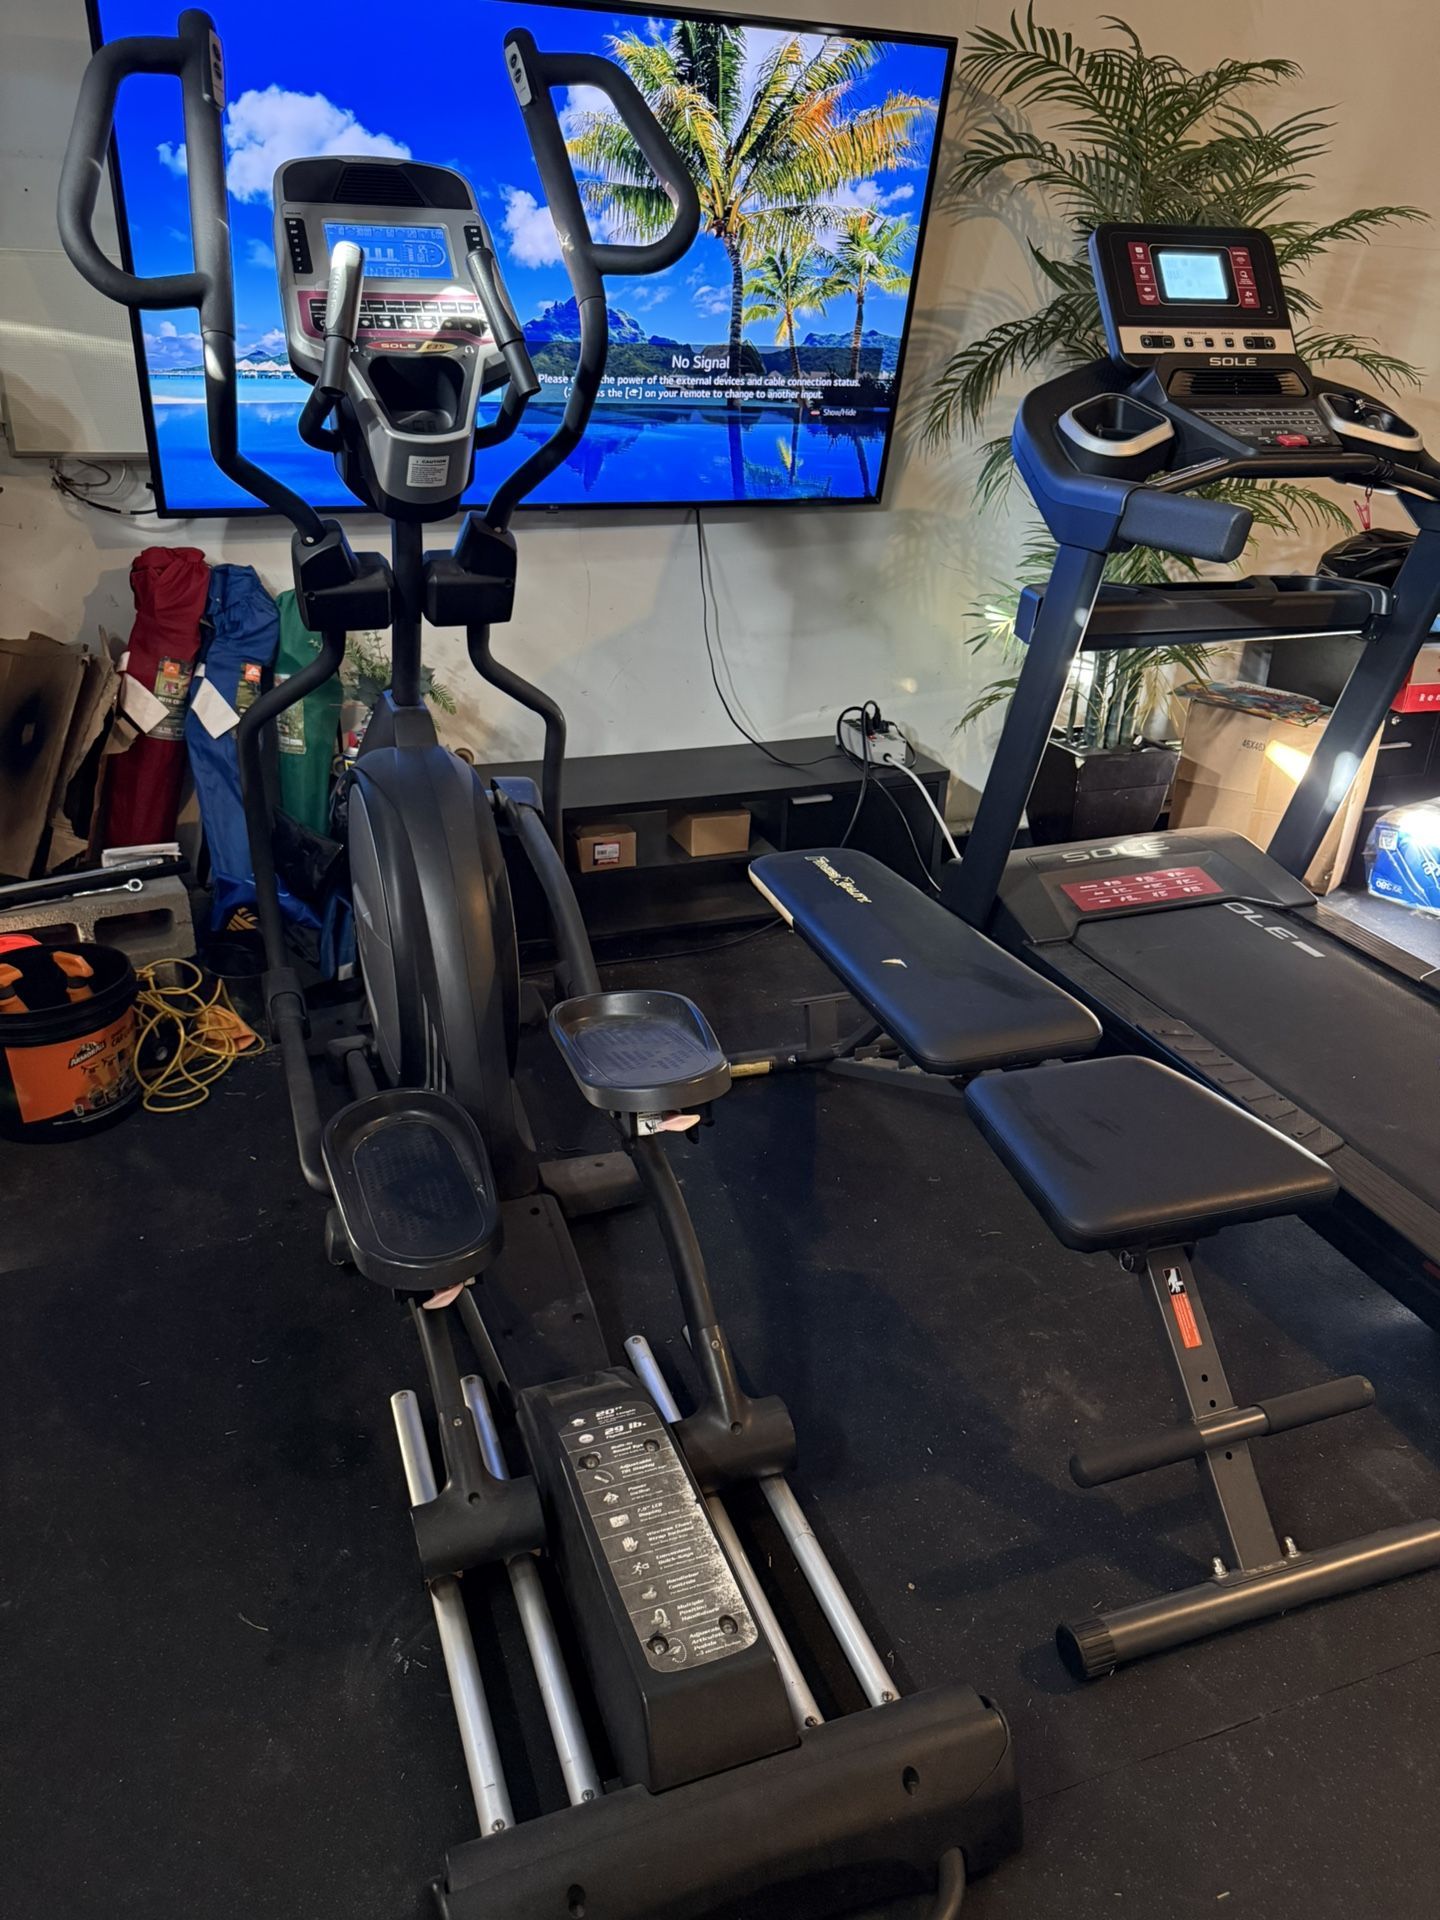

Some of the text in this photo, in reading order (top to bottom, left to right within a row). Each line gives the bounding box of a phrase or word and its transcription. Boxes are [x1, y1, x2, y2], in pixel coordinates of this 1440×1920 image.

[671, 354, 730, 372] No Signal
[1209, 357, 1257, 367] SOLE
[537, 373, 569, 385] Please
[617, 377, 644, 387] power
[647, 375, 658, 385] of
[659, 375, 674, 386] the
[676, 375, 712, 386] external
[713, 375, 745, 387] devices
[746, 376, 762, 387] and
[764, 376, 786, 387] cable
[787, 376, 832, 388] connection
[833, 377, 861, 388] status.
[607, 388, 623, 399] the
[644, 390, 656, 399] on
[657, 390, 679, 400] your
[679, 389, 711, 400] remote
[712, 389, 723, 400] to
[724, 389, 754, 401] change
[755, 390, 766, 400] to
[767, 390, 799, 400] another
[800, 390, 824, 401] input.
[823, 408, 857, 417] Show/Hide
[1062, 840, 1171, 863] SOLE
[1221, 902, 1299, 941] OLE
[604, 1421, 647, 1436] 29 lb.
